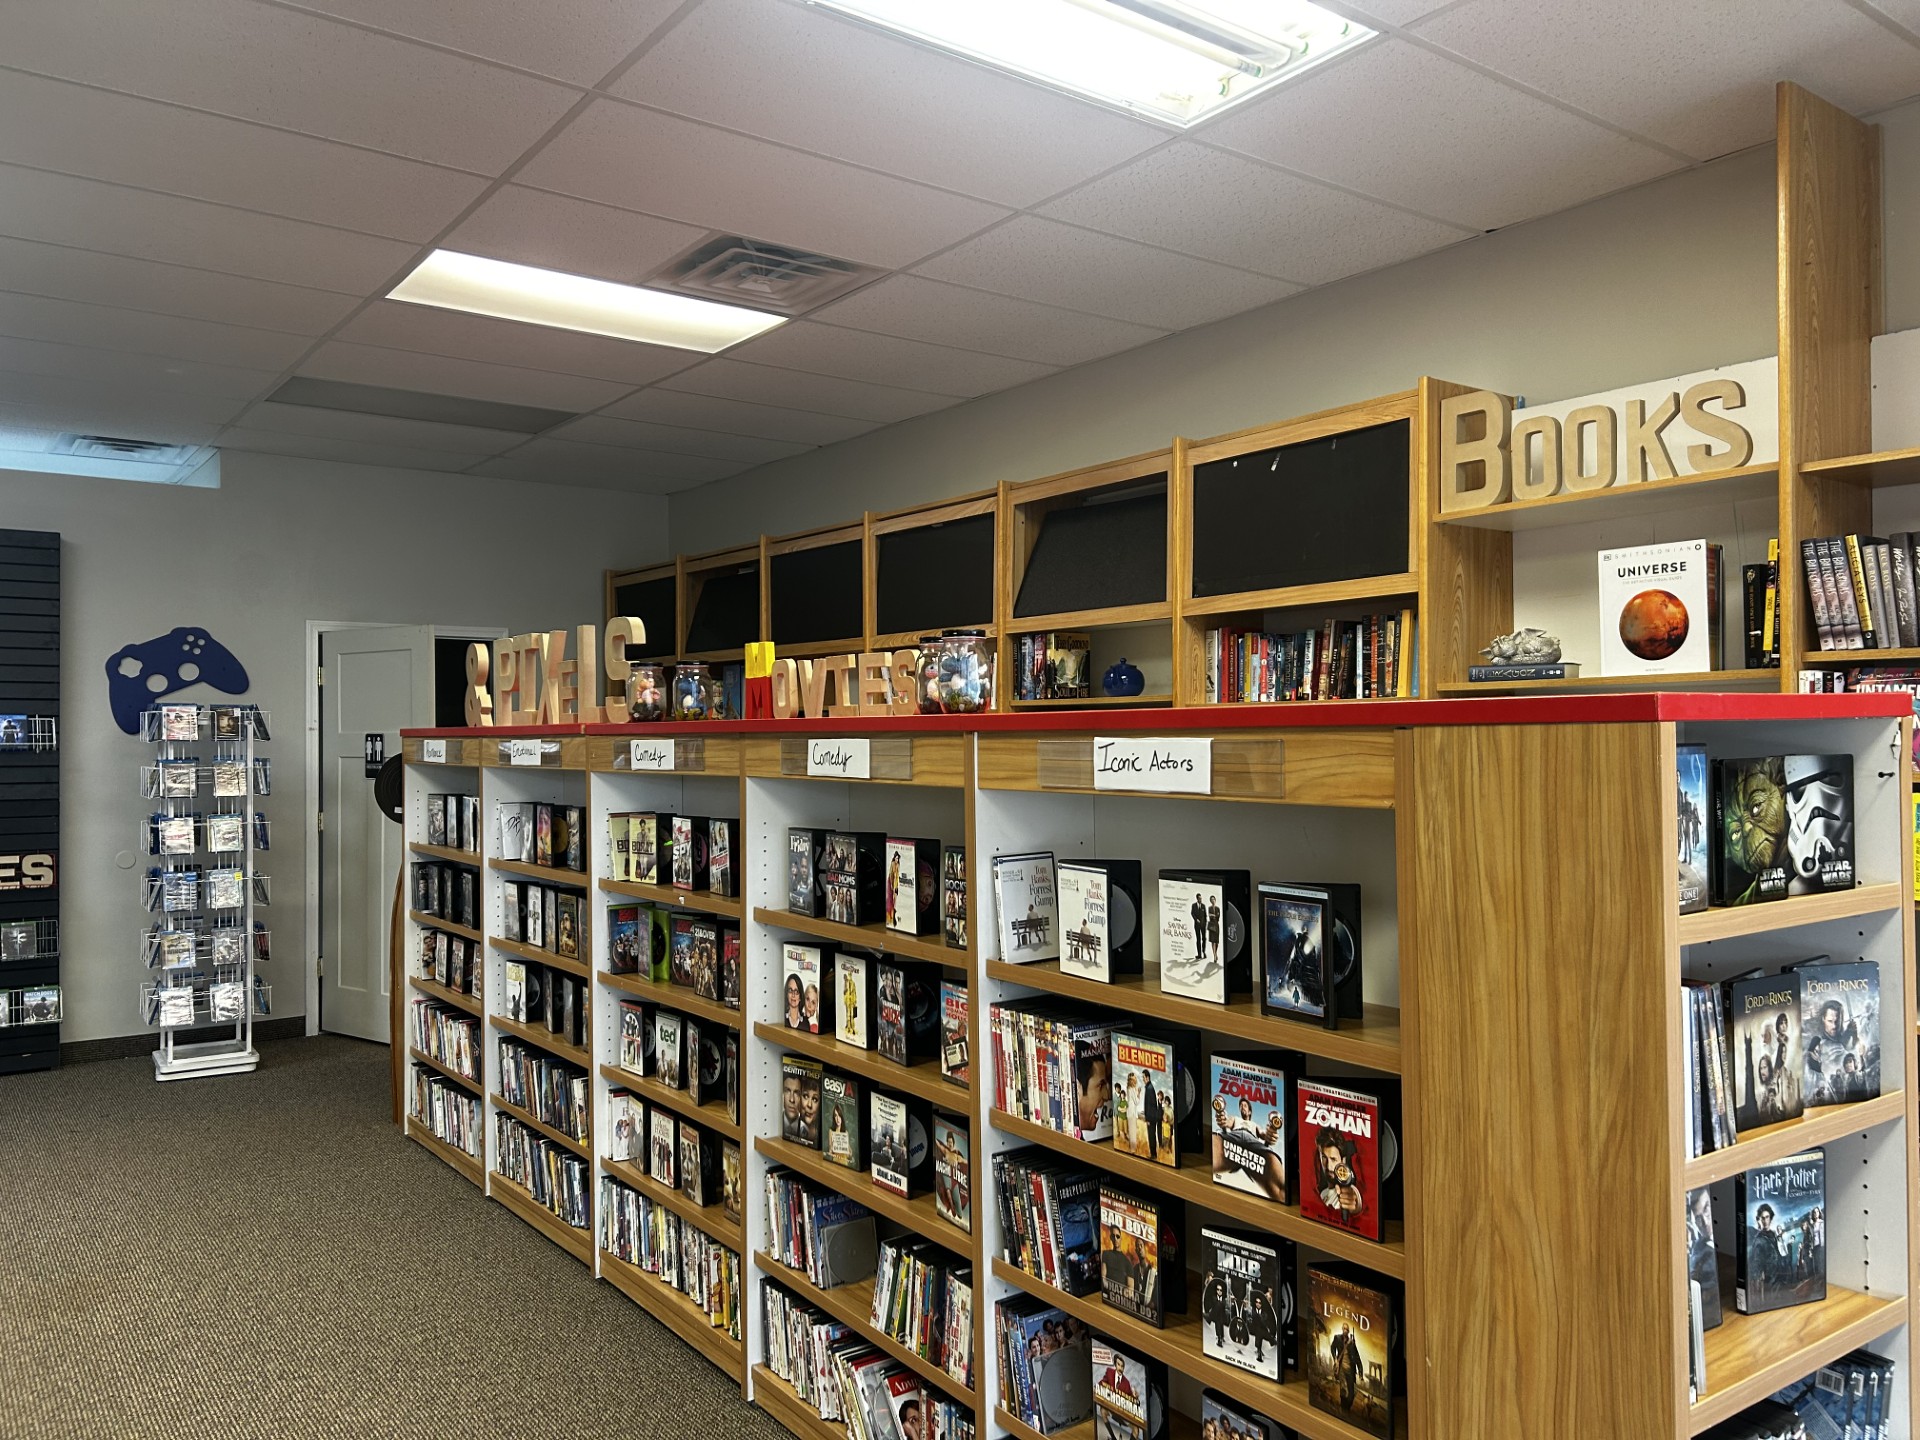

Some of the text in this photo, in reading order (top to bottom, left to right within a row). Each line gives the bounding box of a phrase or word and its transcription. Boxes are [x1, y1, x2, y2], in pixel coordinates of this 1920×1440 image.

[1441, 379, 1753, 513] BOOKS
[1615, 546, 1691, 559] SMITHSONIAN
[1803, 542, 1814, 557] THE
[1816, 541, 1828, 556] THE
[1829, 540, 1842, 555] THE
[1865, 548, 1875, 570] RICK
[1880, 548, 1888, 569] RICK
[1893, 547, 1903, 581] Worthy
[1617, 561, 1687, 578] UNIVERSE
[1849, 544, 1866, 604] ALICIA KEYS
[1869, 571, 1878, 590] ROSS
[1882, 570, 1890, 590] ROSS
[494, 617, 647, 726] PIXELS
[745, 641, 923, 719] MOVIES
[634, 743, 666, 768] Comedy
[812, 742, 853, 773] Comedy
[1098, 742, 1194, 773] Iconic Actors
[1035, 866, 1048, 875] Tom
[1760, 867, 1785, 879] STAR
[1821, 860, 1852, 871] STAR
[838, 873, 856, 885] MOMS
[1090, 879, 1102, 890] Tom
[1760, 879, 1786, 893] WARS
[1822, 871, 1852, 884] WARS
[1029, 884, 1053, 895] Forrest
[1684, 889, 1698, 899] ONE
[1034, 895, 1054, 908] Gump
[1084, 898, 1106, 913] Forrest
[1088, 913, 1106, 927] Gump
[1168, 921, 1188, 930] SAVING
[1174, 930, 1192, 940] BANKS
[1806, 979, 1868, 997] LORD RINGS
[946, 998, 968, 1011] BIG
[1745, 990, 1793, 1013] LORD RINGS
[659, 1025, 676, 1045] ted
[1075, 1031, 1098, 1040] SANDLER
[1118, 1046, 1166, 1070] BLENDED
[783, 1065, 821, 1080] IDENTITY THIEF
[1222, 1067, 1273, 1085] ADAM SANDLER
[1232, 1063, 1280, 1077] EXTENDED VERSION
[824, 1077, 854, 1097] easy A
[1219, 1078, 1277, 1107] ZOHAN
[1298, 1082, 1376, 1104] ORIGINAL THEATRICAL VERSION
[1308, 1094, 1331, 1105] ADAM
[1317, 1102, 1331, 1110] DON'T
[1347, 1109, 1361, 1117] WITH
[1361, 1112, 1371, 1120] THE
[1304, 1105, 1371, 1139] ZOHAN
[1223, 1139, 1266, 1166] UNRATED
[1223, 1149, 1265, 1175] VERSION
[1753, 1173, 1782, 1199] Harry
[1785, 1166, 1817, 1200] Potter
[1100, 1188, 1156, 1213] SPECIAL EDITION
[1101, 1208, 1156, 1243] BAD BOYS
[1222, 1243, 1237, 1253] JONES
[1250, 1252, 1266, 1262] SMITH
[1217, 1265, 1230, 1274] MEN
[1238, 1271, 1257, 1282] BLACK
[1102, 1278, 1141, 1304] WHATCHA
[1109, 1291, 1158, 1321] GONNA DO?
[1323, 1301, 1370, 1331] LEGEND
[1243, 1361, 1256, 1370] BLACK
[1095, 1383, 1145, 1420] ANCHORMAN
